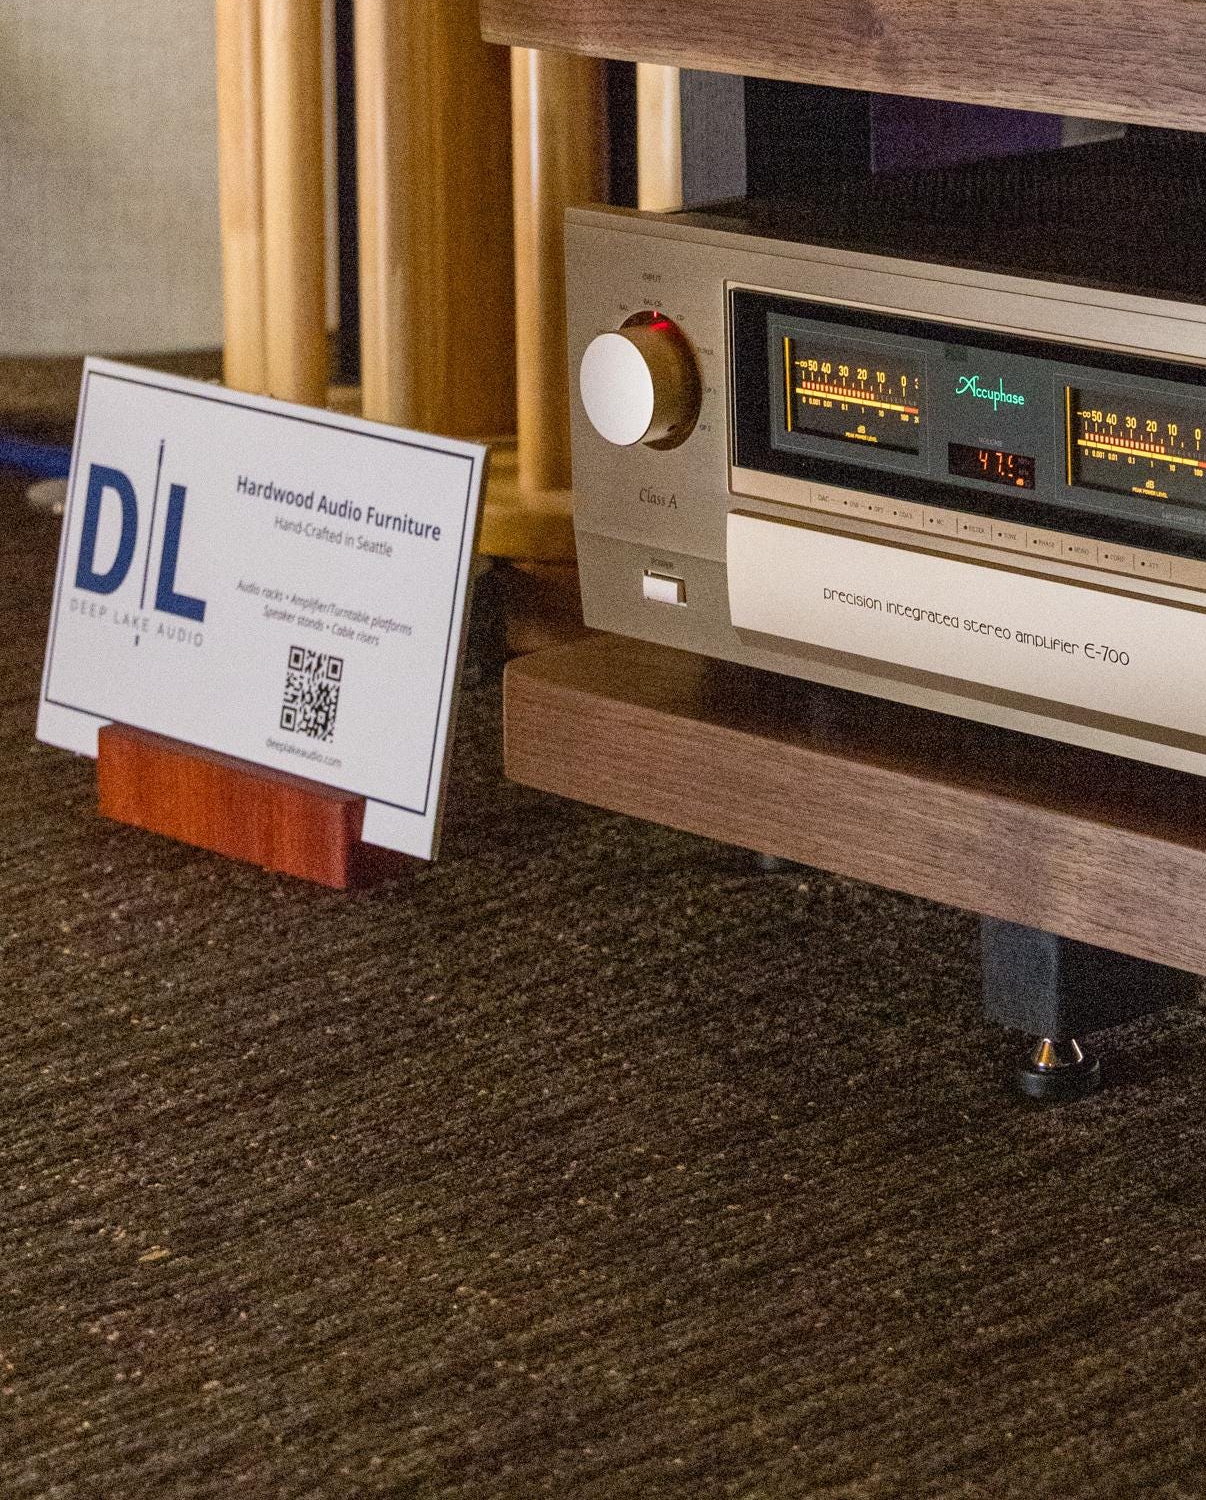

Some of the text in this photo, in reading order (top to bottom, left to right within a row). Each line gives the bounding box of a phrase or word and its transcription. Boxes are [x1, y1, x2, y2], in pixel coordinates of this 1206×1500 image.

[808, 360, 818, 372] 50
[821, 363, 831, 374] 40
[839, 365, 849, 377] 30
[857, 368, 867, 380] 20
[876, 372, 885, 383] 10
[901, 375, 907, 387] 0
[956, 375, 1025, 411] Accuphase
[1091, 410, 1102, 423] 50
[1106, 413, 1117, 425] 40
[1125, 416, 1137, 429] 30
[1146, 420, 1157, 432] 20
[1167, 424, 1177, 436] 10
[1195, 428, 1201, 440] 0
[1092, 450, 1104, 459] 0.001
[1108, 453, 1118, 461] 0.01
[1169, 464, 1176, 472] 10
[639, 486, 677, 509] Class A
[1145, 480, 1155, 489] dB
[236, 475, 441, 541] Hardwood Audio Furniture
[273, 516, 393, 557] Hand-Crafted in Seattle
[69, 597, 204, 647] DEEP LAKE AUDIO
[236, 580, 261, 596] Audio
[290, 592, 370, 624] Amplifier/Turntable
[370, 615, 412, 636] platforms
[263, 604, 379, 646] Speaker stands Cable risers
[823, 587, 1130, 666] precision integrated stereo amplifier E-700
